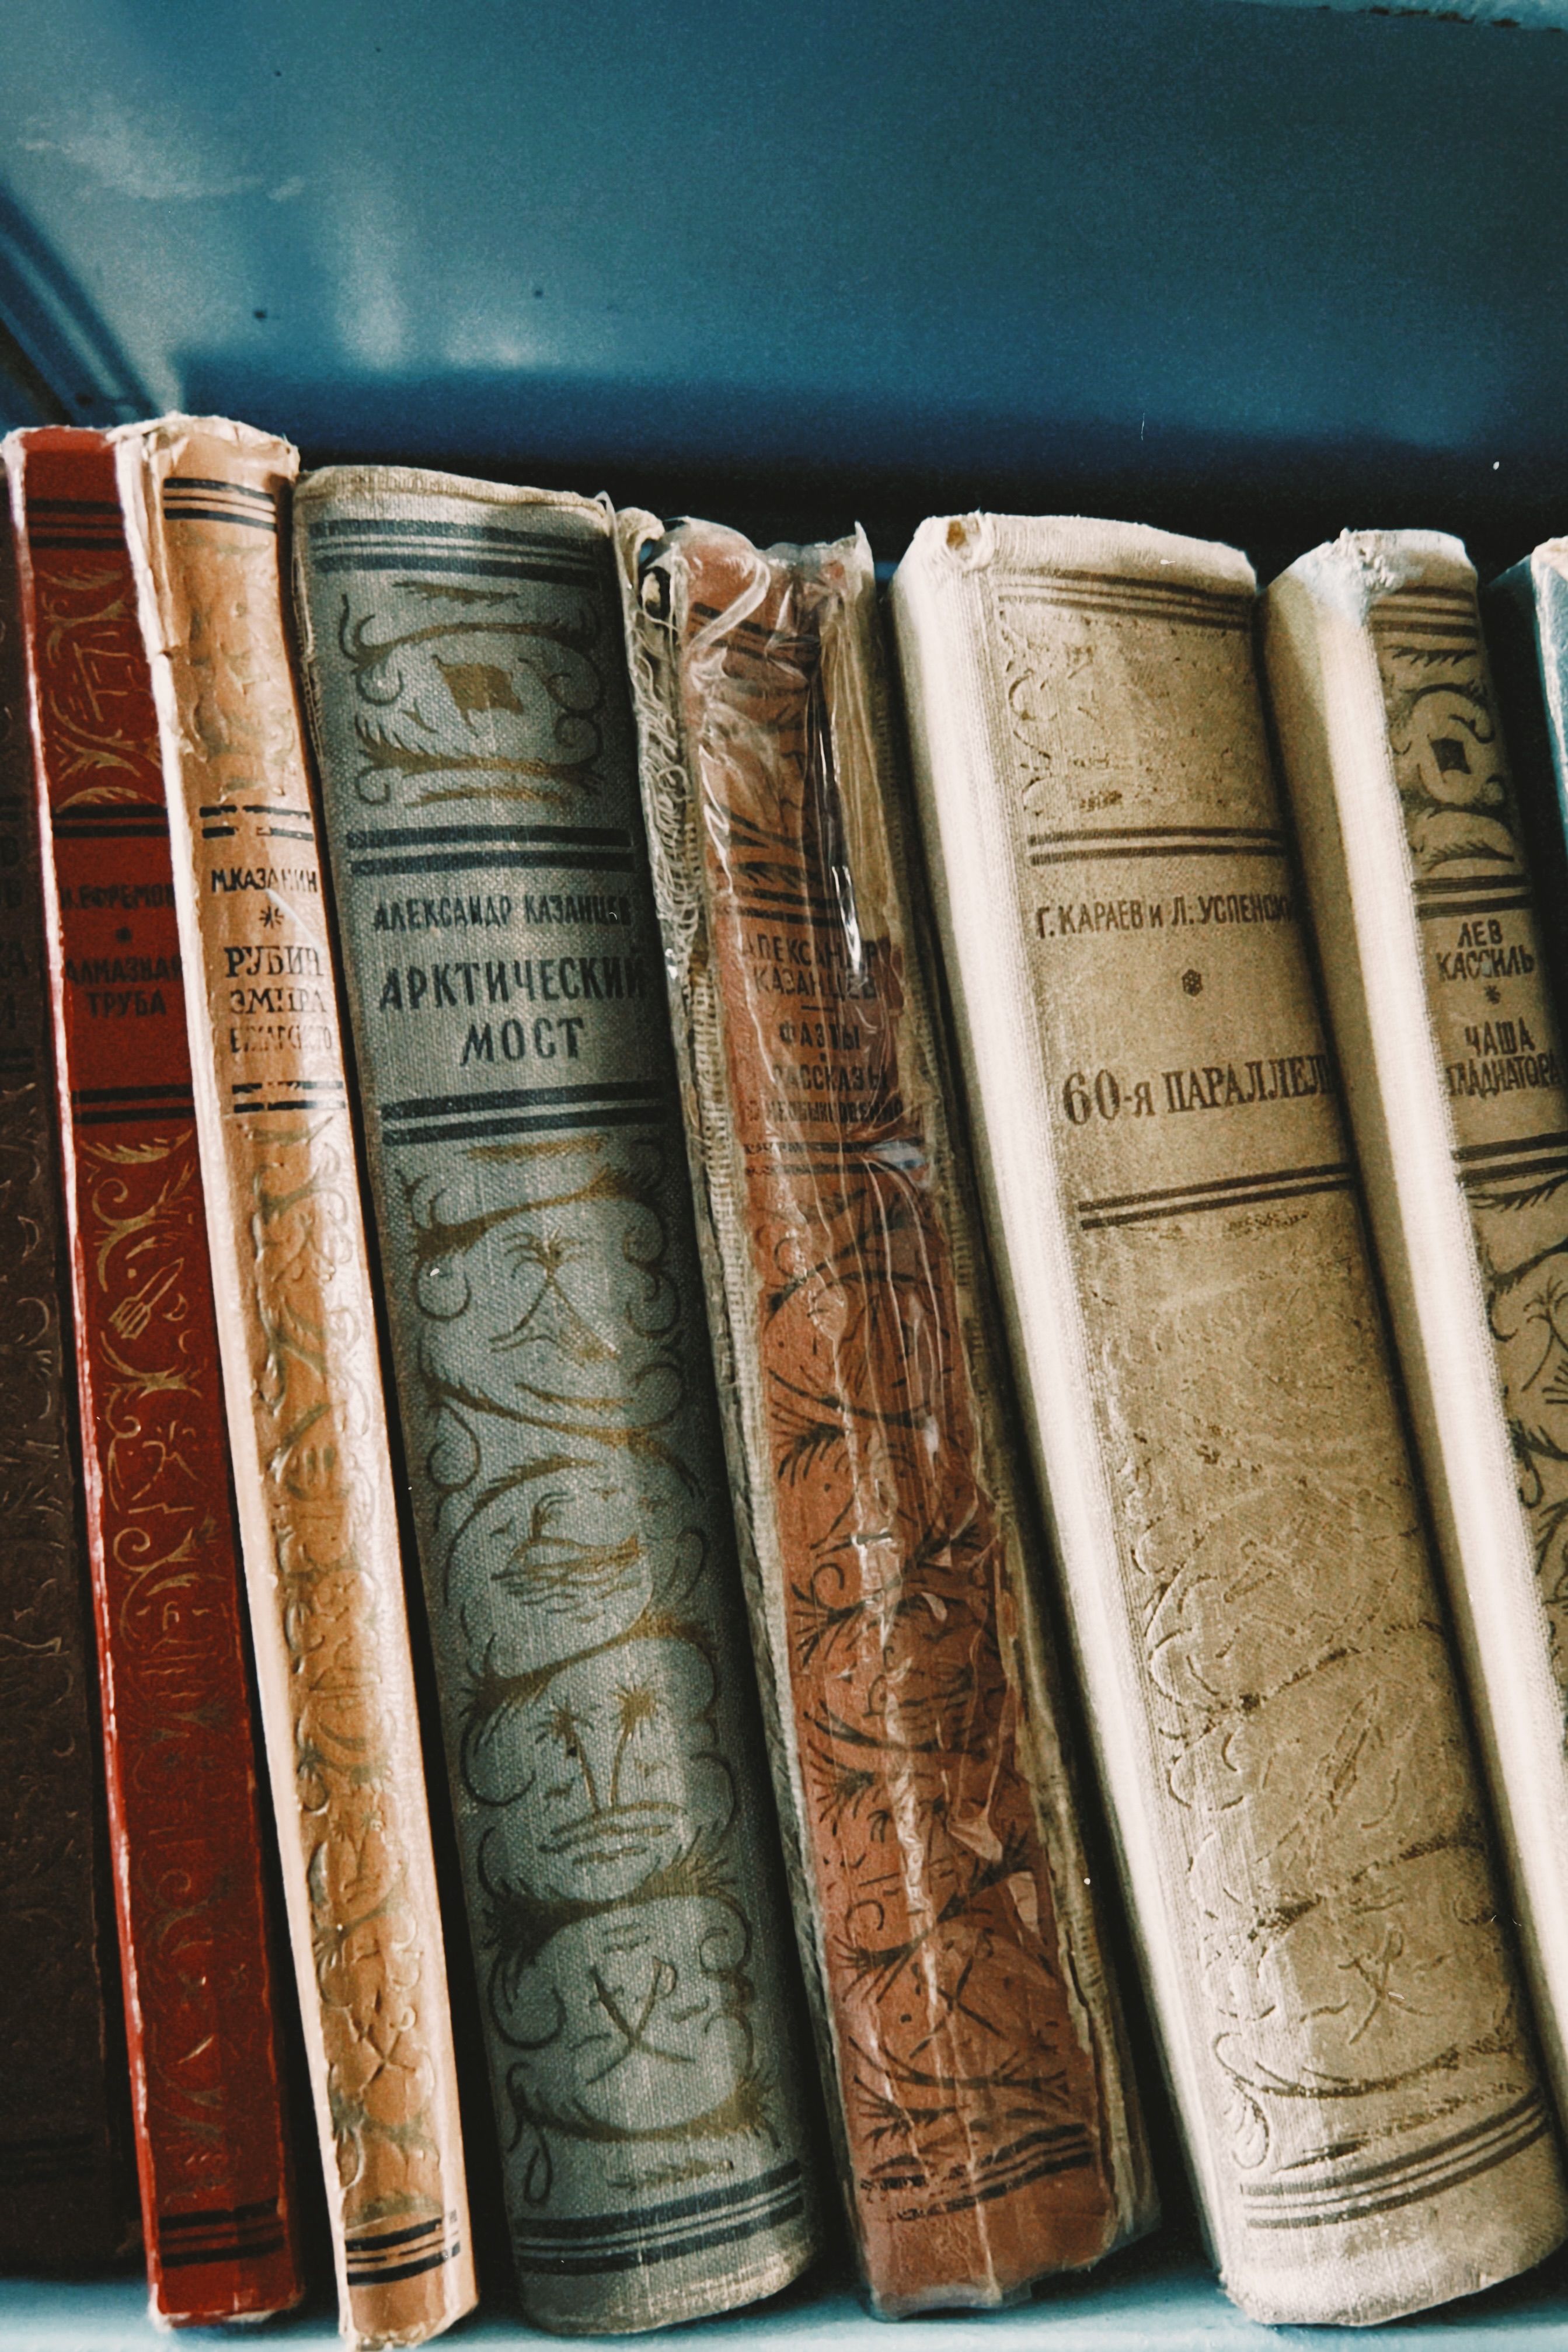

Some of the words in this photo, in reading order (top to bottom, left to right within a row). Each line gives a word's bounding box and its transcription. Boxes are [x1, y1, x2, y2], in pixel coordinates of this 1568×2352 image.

[375, 895, 511, 931] АЛЕКСАНДР
[525, 894, 633, 926] КАЗАНЦЕВ
[1458, 919, 1503, 948] ЛЕВ
[224, 946, 324, 978] РУБИН
[1436, 945, 1535, 981] КАССИЛЬ
[87, 989, 166, 1018] ТРУБА
[460, 1016, 584, 1067] МОСТ
[1465, 1016, 1536, 1058] ЧАША
[1062, 1069, 1156, 1126] 60-я
